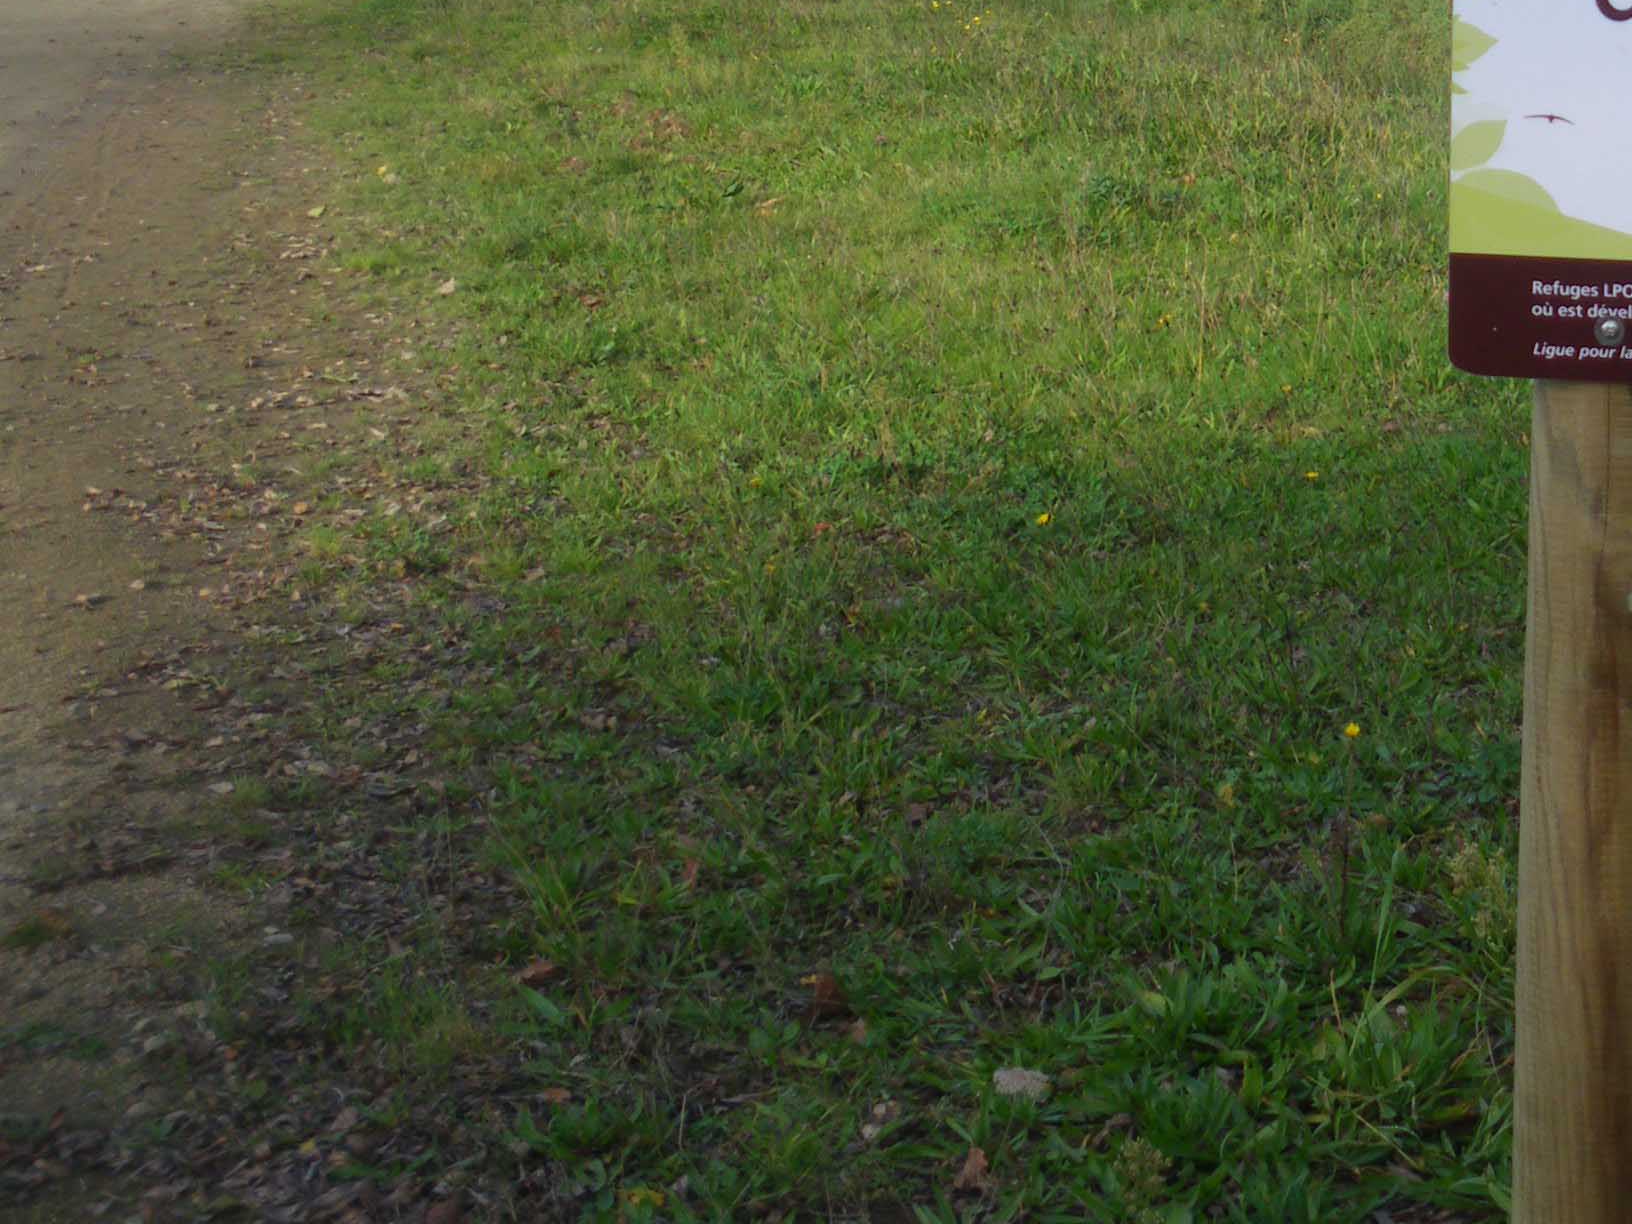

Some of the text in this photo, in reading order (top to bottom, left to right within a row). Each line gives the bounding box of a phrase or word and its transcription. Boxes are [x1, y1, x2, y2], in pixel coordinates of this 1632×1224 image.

[1531, 280, 1599, 300] Refuges
[1531, 302, 1553, 317] où
[1557, 304, 1583, 318] est
[1533, 342, 1575, 360] Ligue
[1578, 345, 1616, 361] pour
